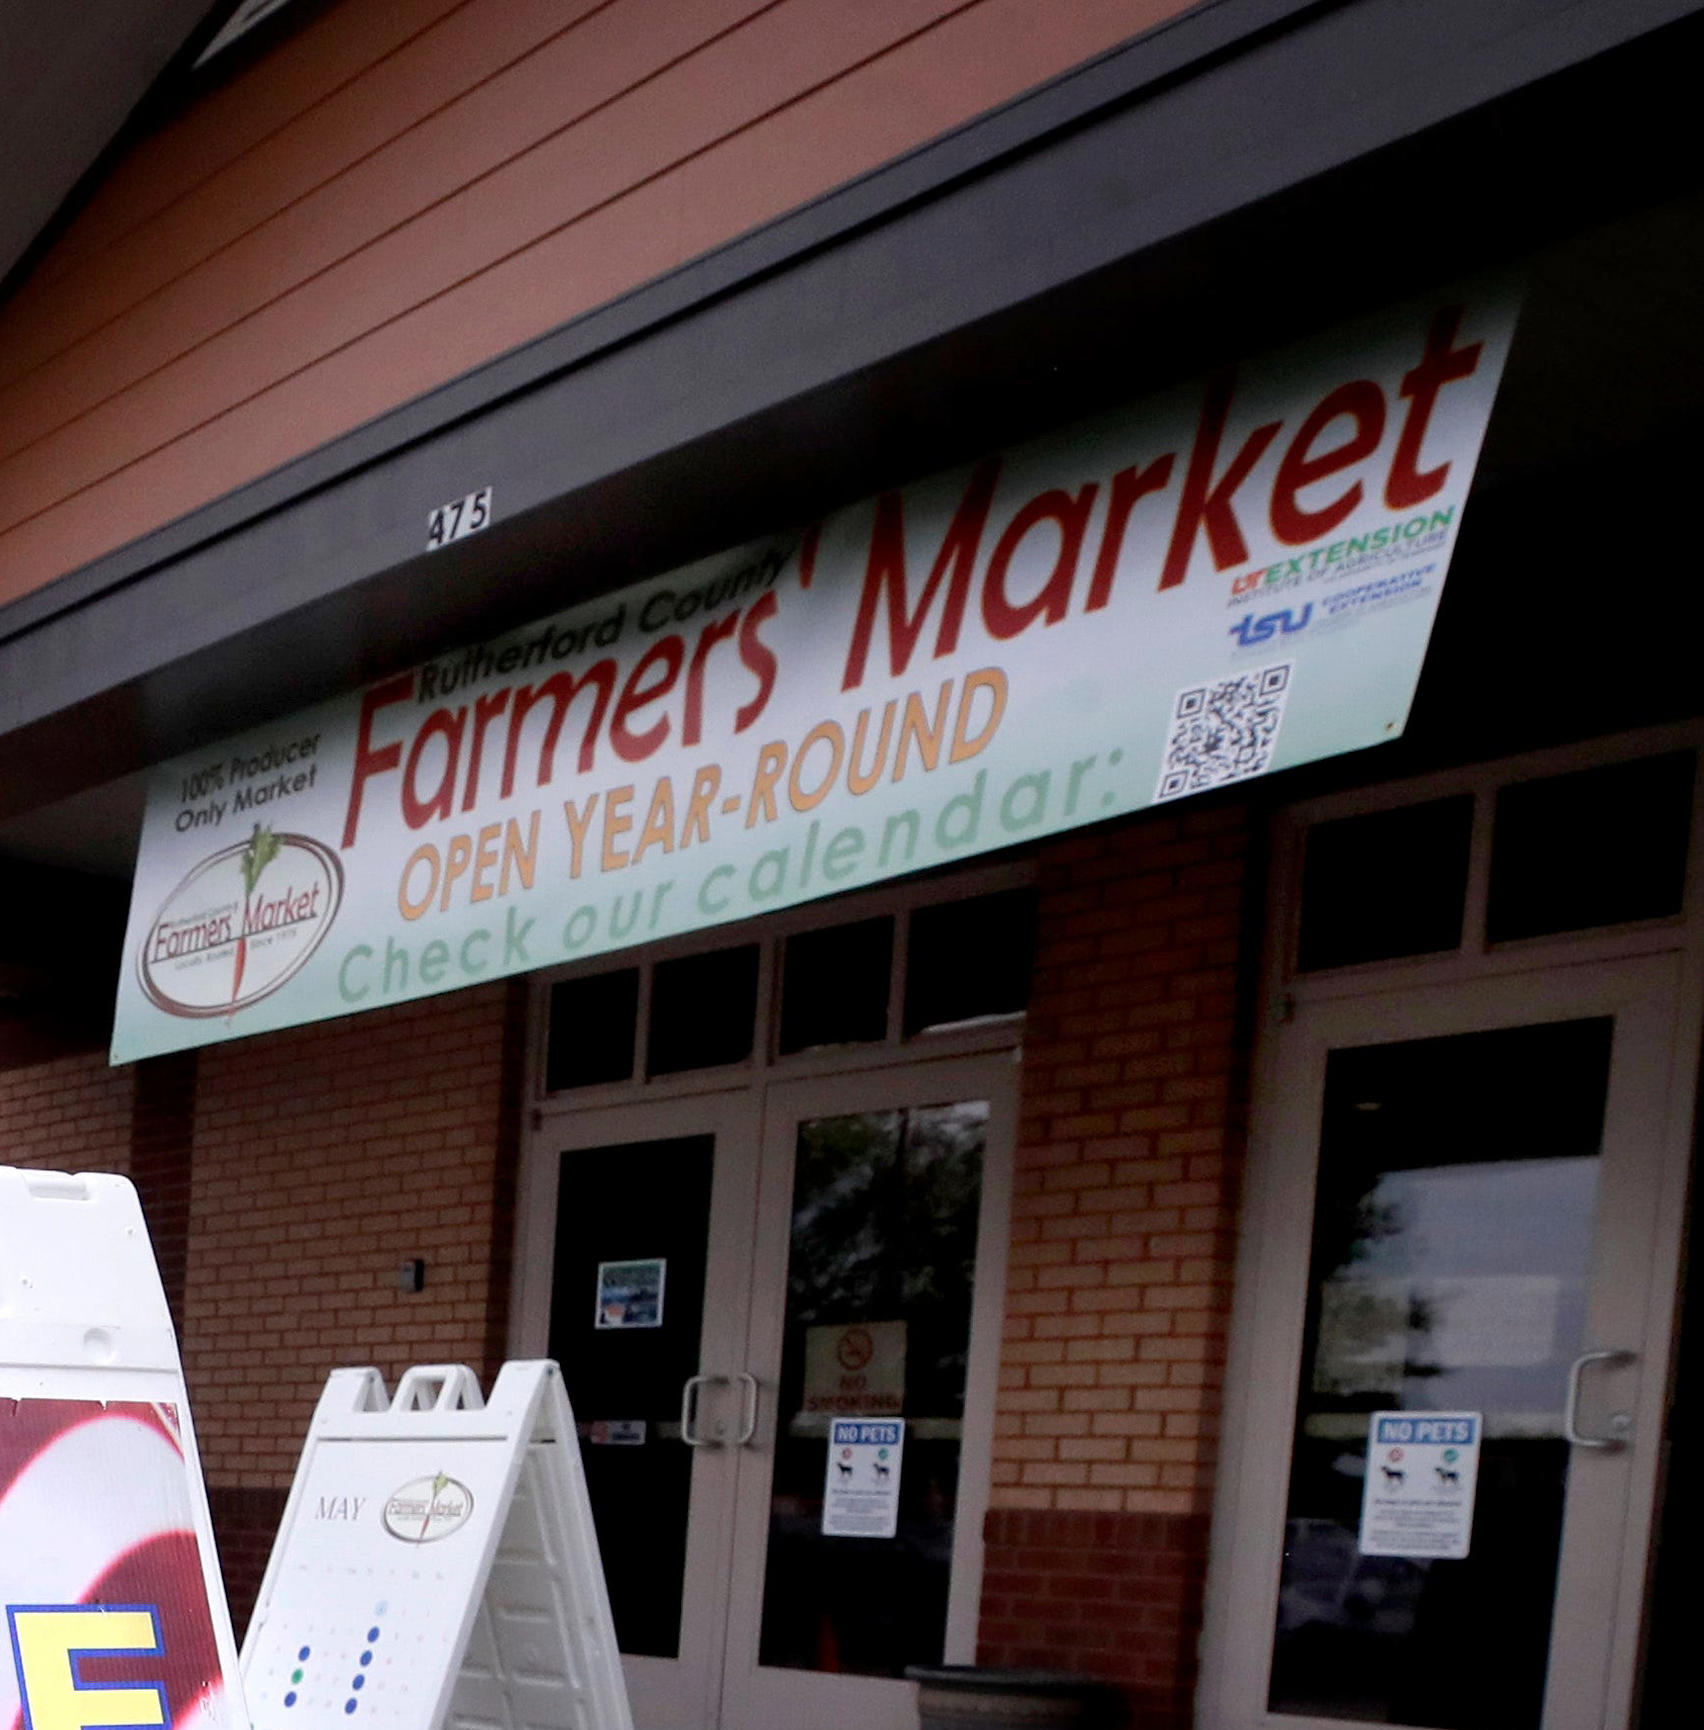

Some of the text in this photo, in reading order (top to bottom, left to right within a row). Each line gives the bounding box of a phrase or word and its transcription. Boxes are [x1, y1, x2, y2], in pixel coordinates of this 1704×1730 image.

[429, 490, 488, 545] 475
[840, 303, 1484, 694] Market
[417, 602, 626, 704] Rutherford
[229, 733, 321, 785] Producer
[175, 763, 318, 833] Only Market
[398, 667, 1009, 921] OPEN YEAR-ROUND
[337, 746, 1127, 1004] Check our calendar:
[242, 880, 321, 935] Market
[837, 1424, 896, 1443] NO PETS
[1382, 1421, 1469, 1442] NO PETS
[314, 1495, 366, 1522] MAY
